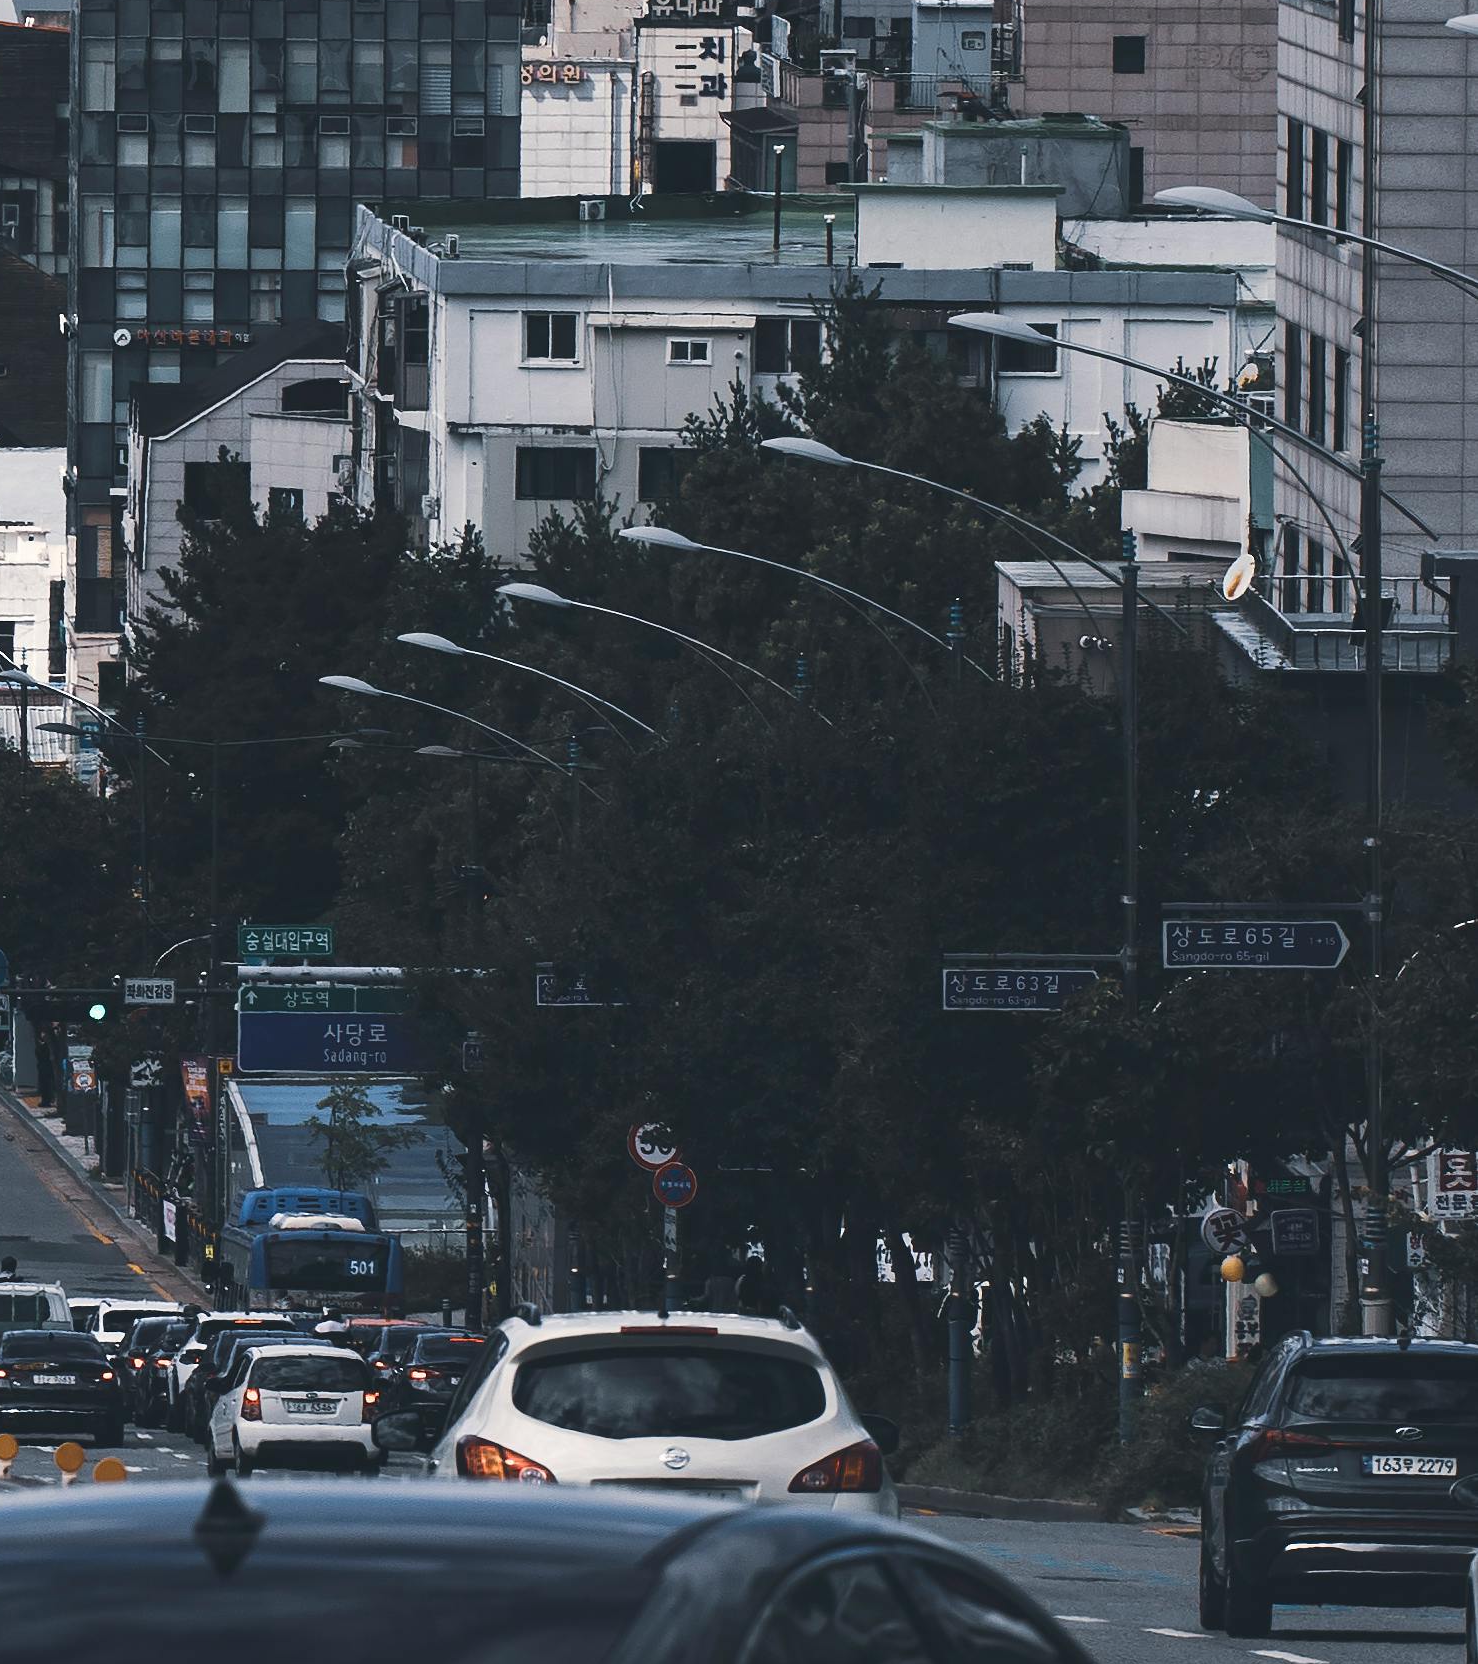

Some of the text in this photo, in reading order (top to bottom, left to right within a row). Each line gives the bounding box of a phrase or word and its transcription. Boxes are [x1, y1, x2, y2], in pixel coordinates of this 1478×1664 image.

[245, 930, 330, 954] 숭실대입구역
[1171, 926, 1297, 948] 상도로65길
[1172, 950, 1272, 964] Sangdo-ro 65-gil
[950, 975, 1059, 994] 상도로63길
[284, 991, 330, 1009] 상도역
[323, 1024, 389, 1047] 사당로
[324, 1049, 388, 1067] Sadang-ro
[349, 1260, 376, 1276] 501
[1418, 1458, 1455, 1475] 2279
